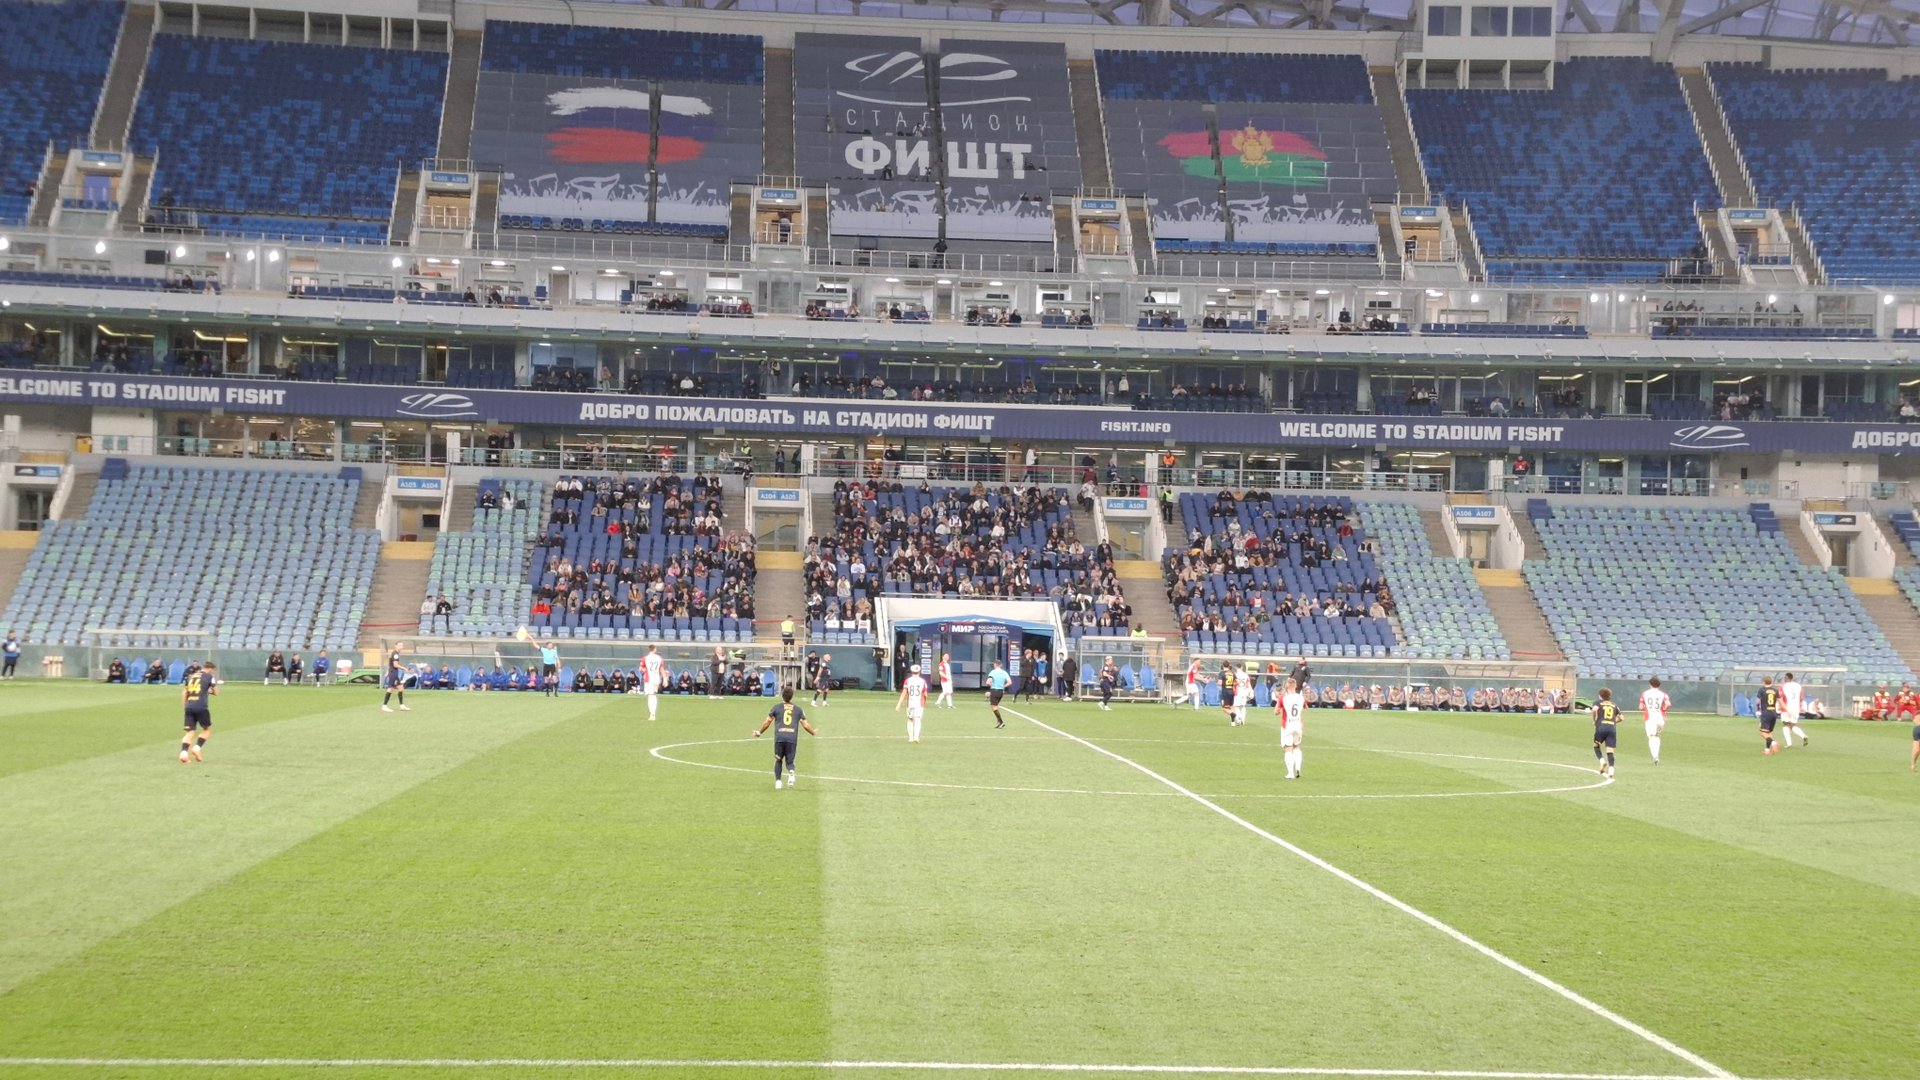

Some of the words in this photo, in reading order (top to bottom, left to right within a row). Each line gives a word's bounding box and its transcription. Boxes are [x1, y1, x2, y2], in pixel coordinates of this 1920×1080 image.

[846, 108, 1028, 132] СТАДИОН
[844, 136, 1032, 180] ФИШТ
[89, 381, 117, 398] TO
[122, 383, 220, 402] STADIUM
[226, 387, 287, 405] FISHT
[579, 402, 649, 420] ДОБРО
[655, 405, 795, 424] ПОЖАЛОВАТЬ
[803, 410, 831, 425] НА
[836, 411, 928, 430] СТАДИОН
[933, 414, 995, 430] ФИШТ
[1101, 421, 1171, 433] FISHT.INFO
[1280, 422, 1376, 438] WELCOME
[1382, 424, 1407, 439] TO
[1413, 424, 1502, 441] STADIUM
[1507, 426, 1564, 442] FISHT
[1852, 431, 1920, 448] ДОБРО
[951, 625, 975, 633] МИР
[649, 661, 659, 672] 27
[909, 684, 921, 697] 83
[783, 709, 792, 725] 6
[1291, 703, 1299, 718] 6
[1603, 705, 1614, 719] 19
